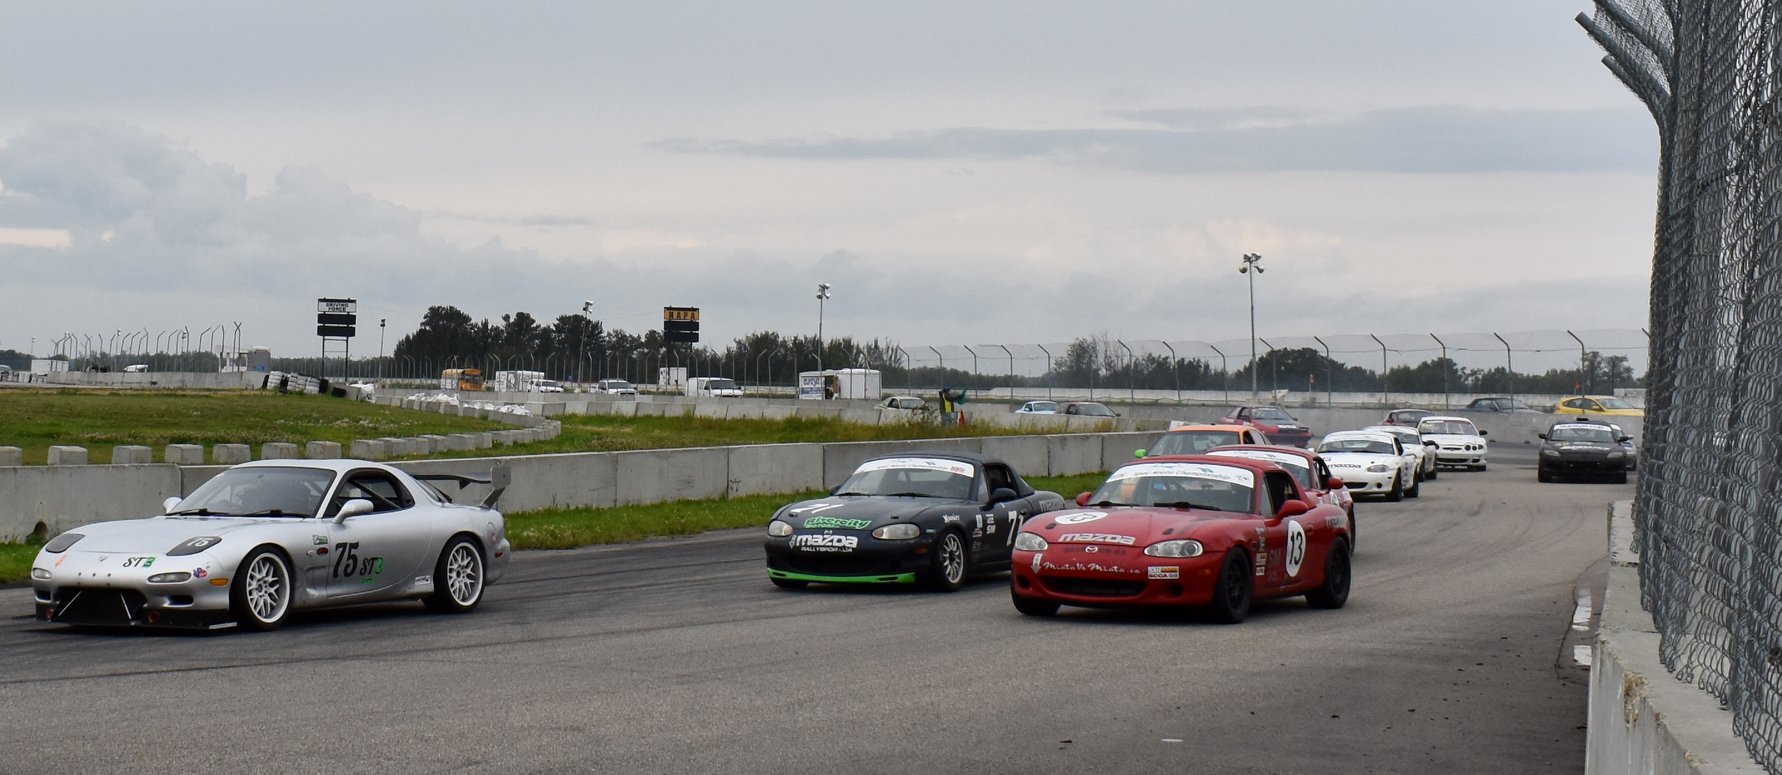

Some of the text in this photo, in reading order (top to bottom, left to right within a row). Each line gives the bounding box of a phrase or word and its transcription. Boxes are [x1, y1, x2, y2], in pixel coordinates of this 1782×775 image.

[668, 311, 695, 319] NAPA
[186, 536, 216, 548] 75
[1289, 530, 1303, 566] 13
[332, 541, 360, 579] 75
